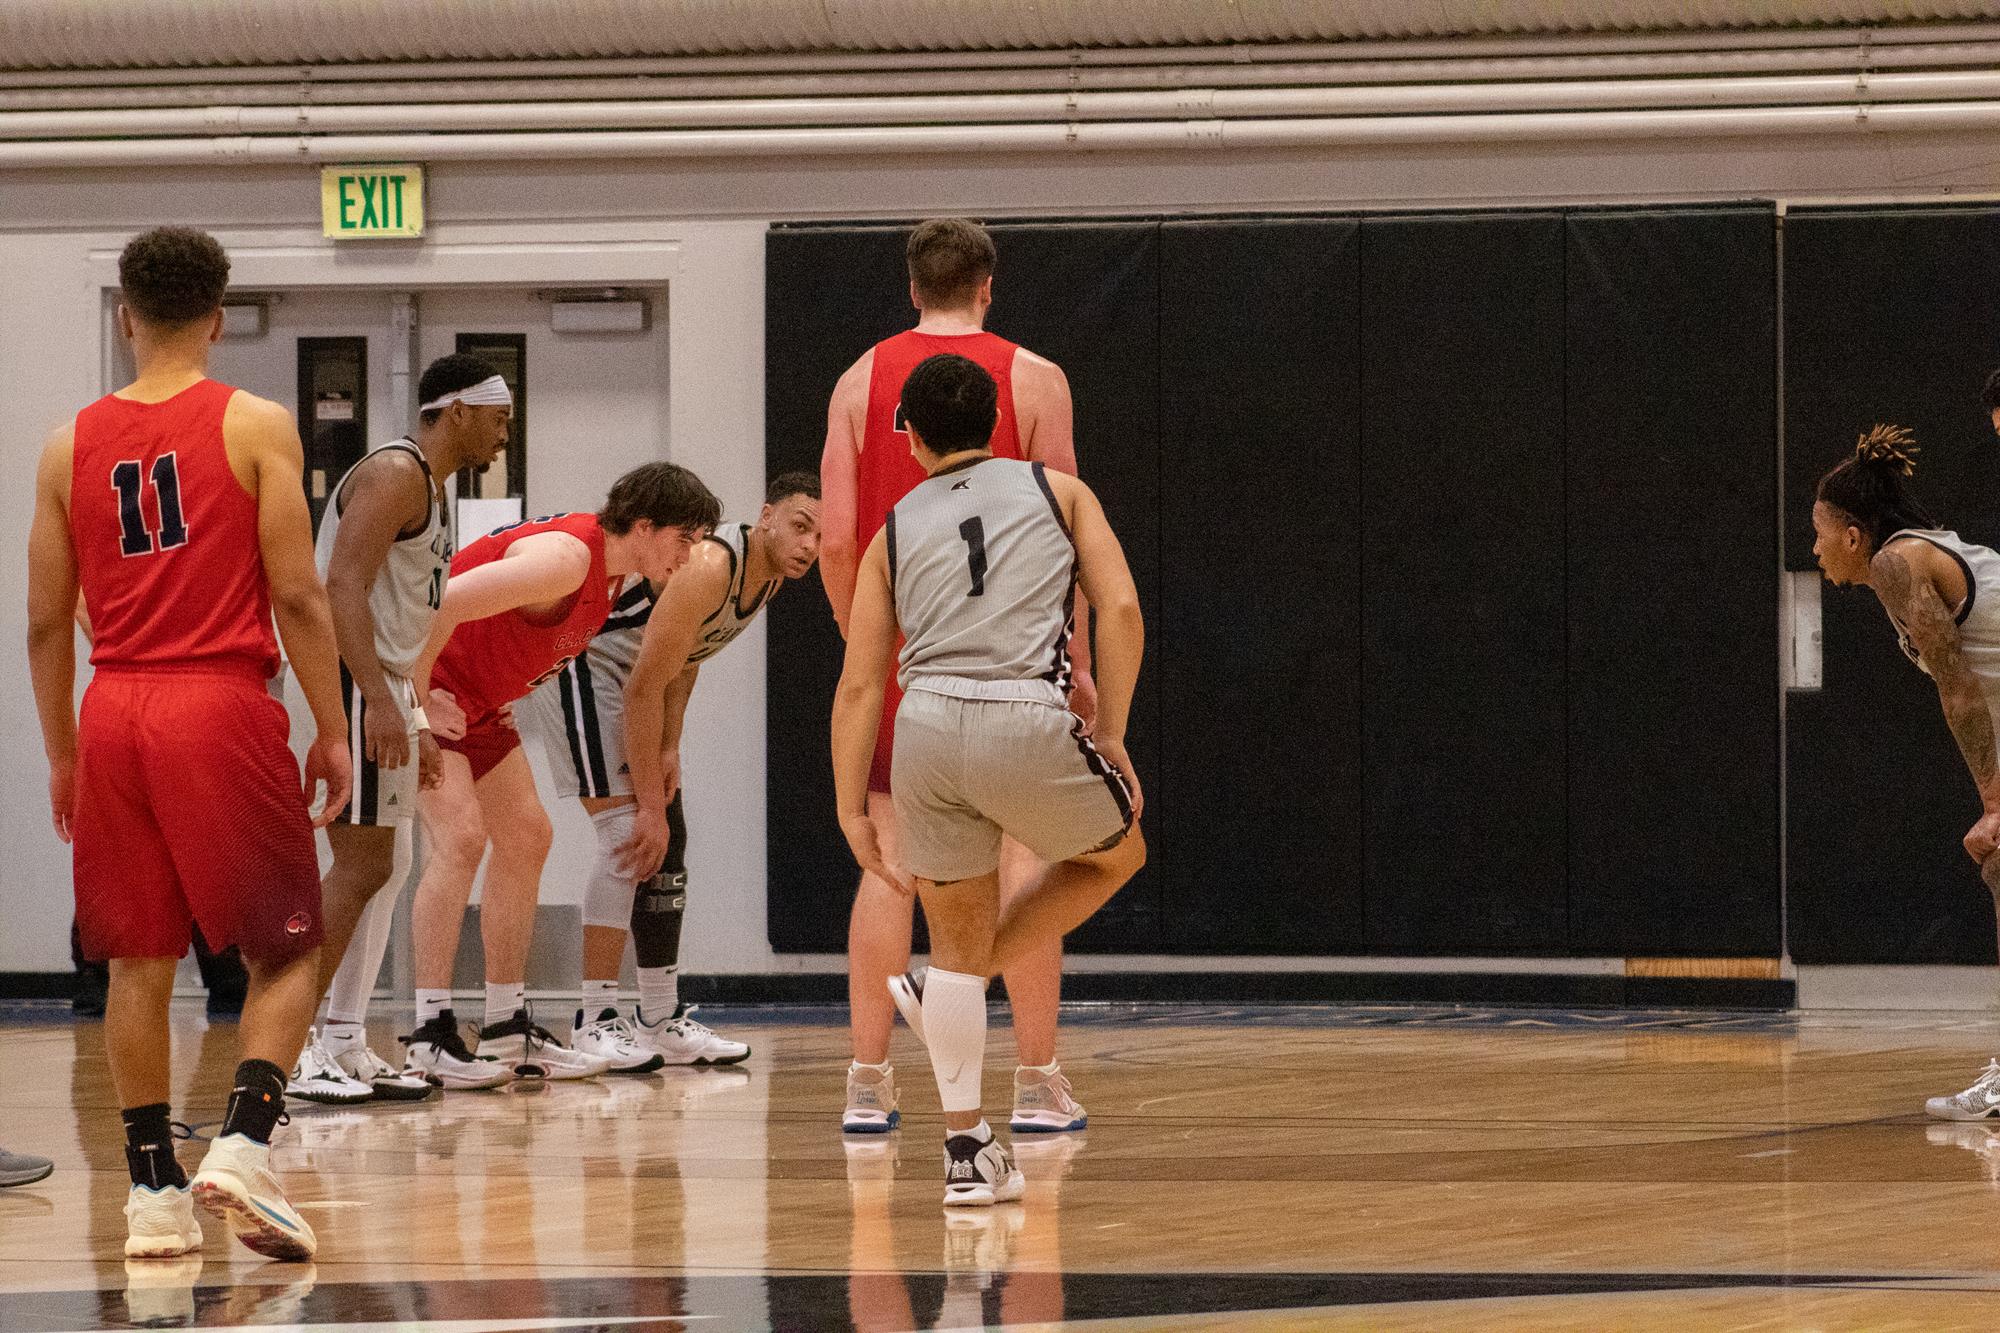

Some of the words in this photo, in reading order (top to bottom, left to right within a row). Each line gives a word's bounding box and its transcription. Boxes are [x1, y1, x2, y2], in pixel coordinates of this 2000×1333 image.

[338, 175, 407, 229] EXIT
[110, 450, 189, 558] 11
[958, 516, 988, 597] 1
